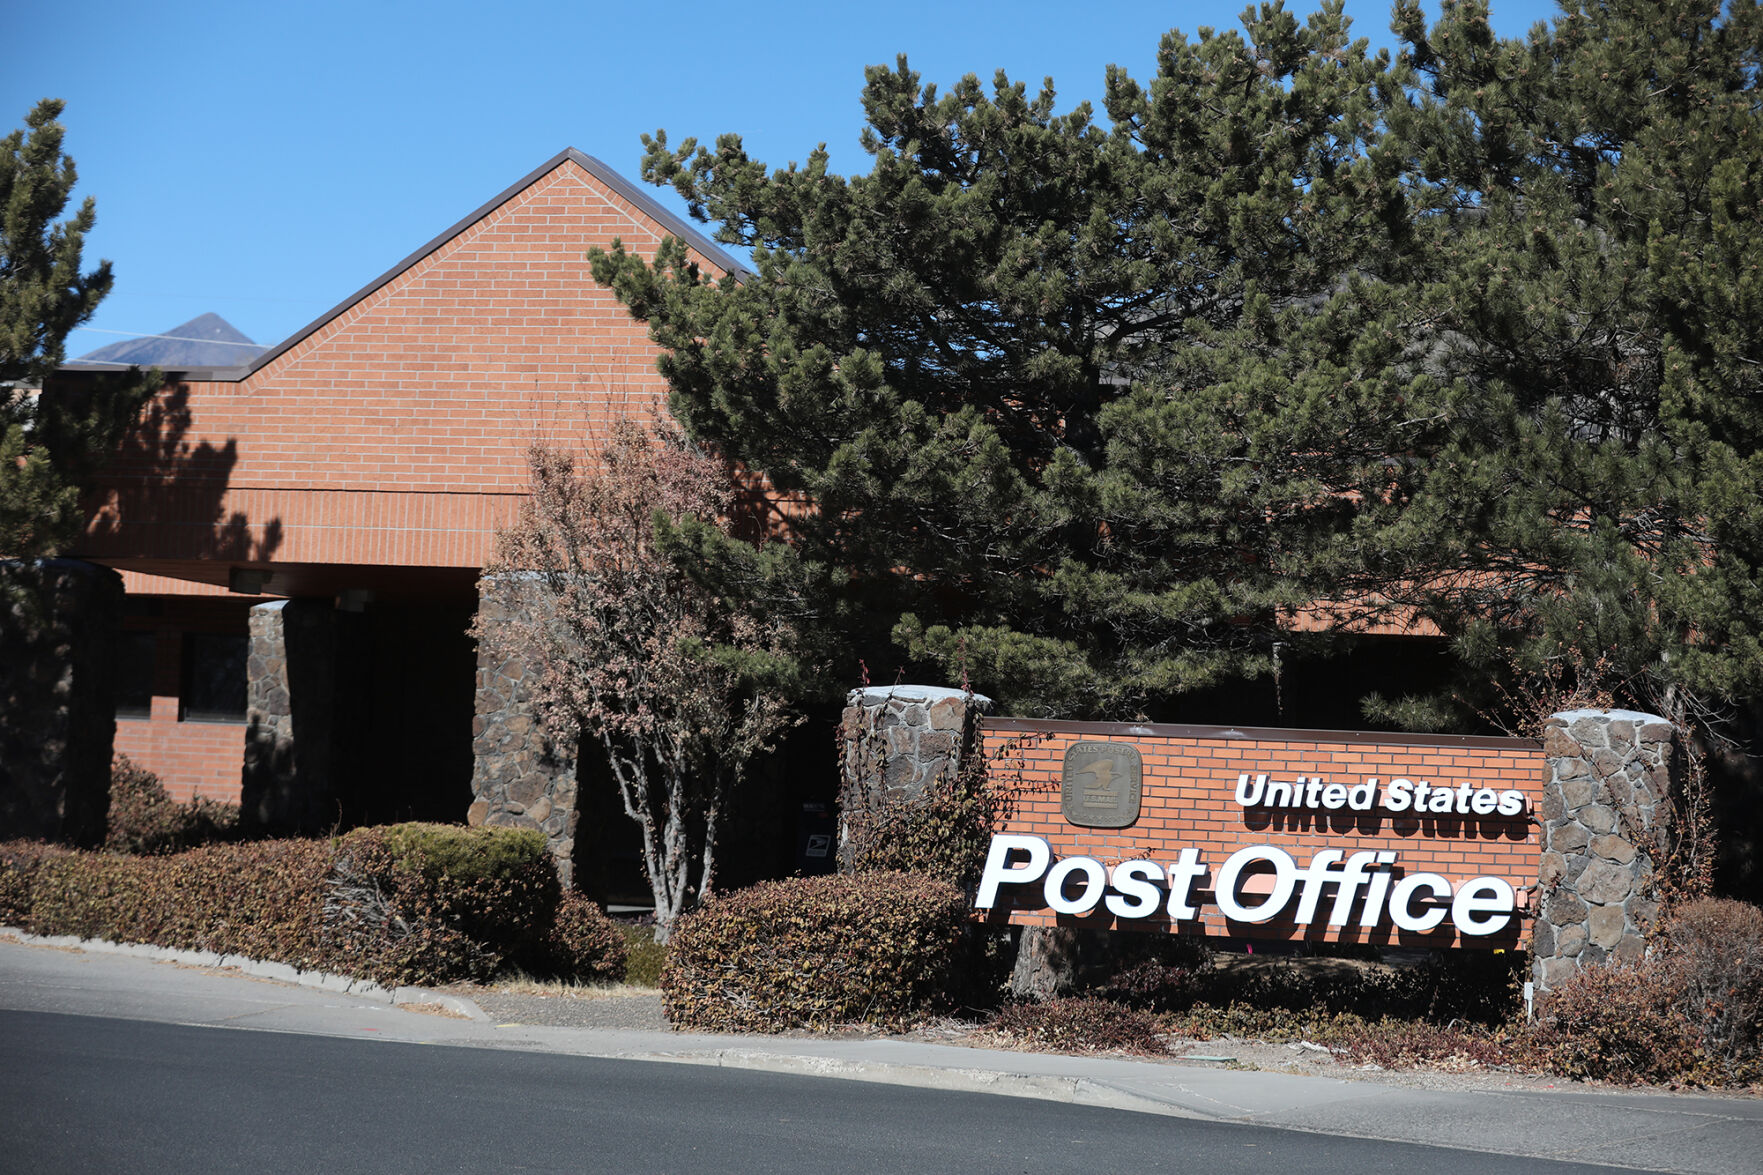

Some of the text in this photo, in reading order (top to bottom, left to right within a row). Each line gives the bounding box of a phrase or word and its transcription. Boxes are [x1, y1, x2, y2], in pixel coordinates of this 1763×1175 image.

[1068, 745, 1098, 761] STATES
[1101, 745, 1136, 760] POSTAL
[1234, 774, 1524, 816] United States
[974, 834, 1514, 935] Post Office
